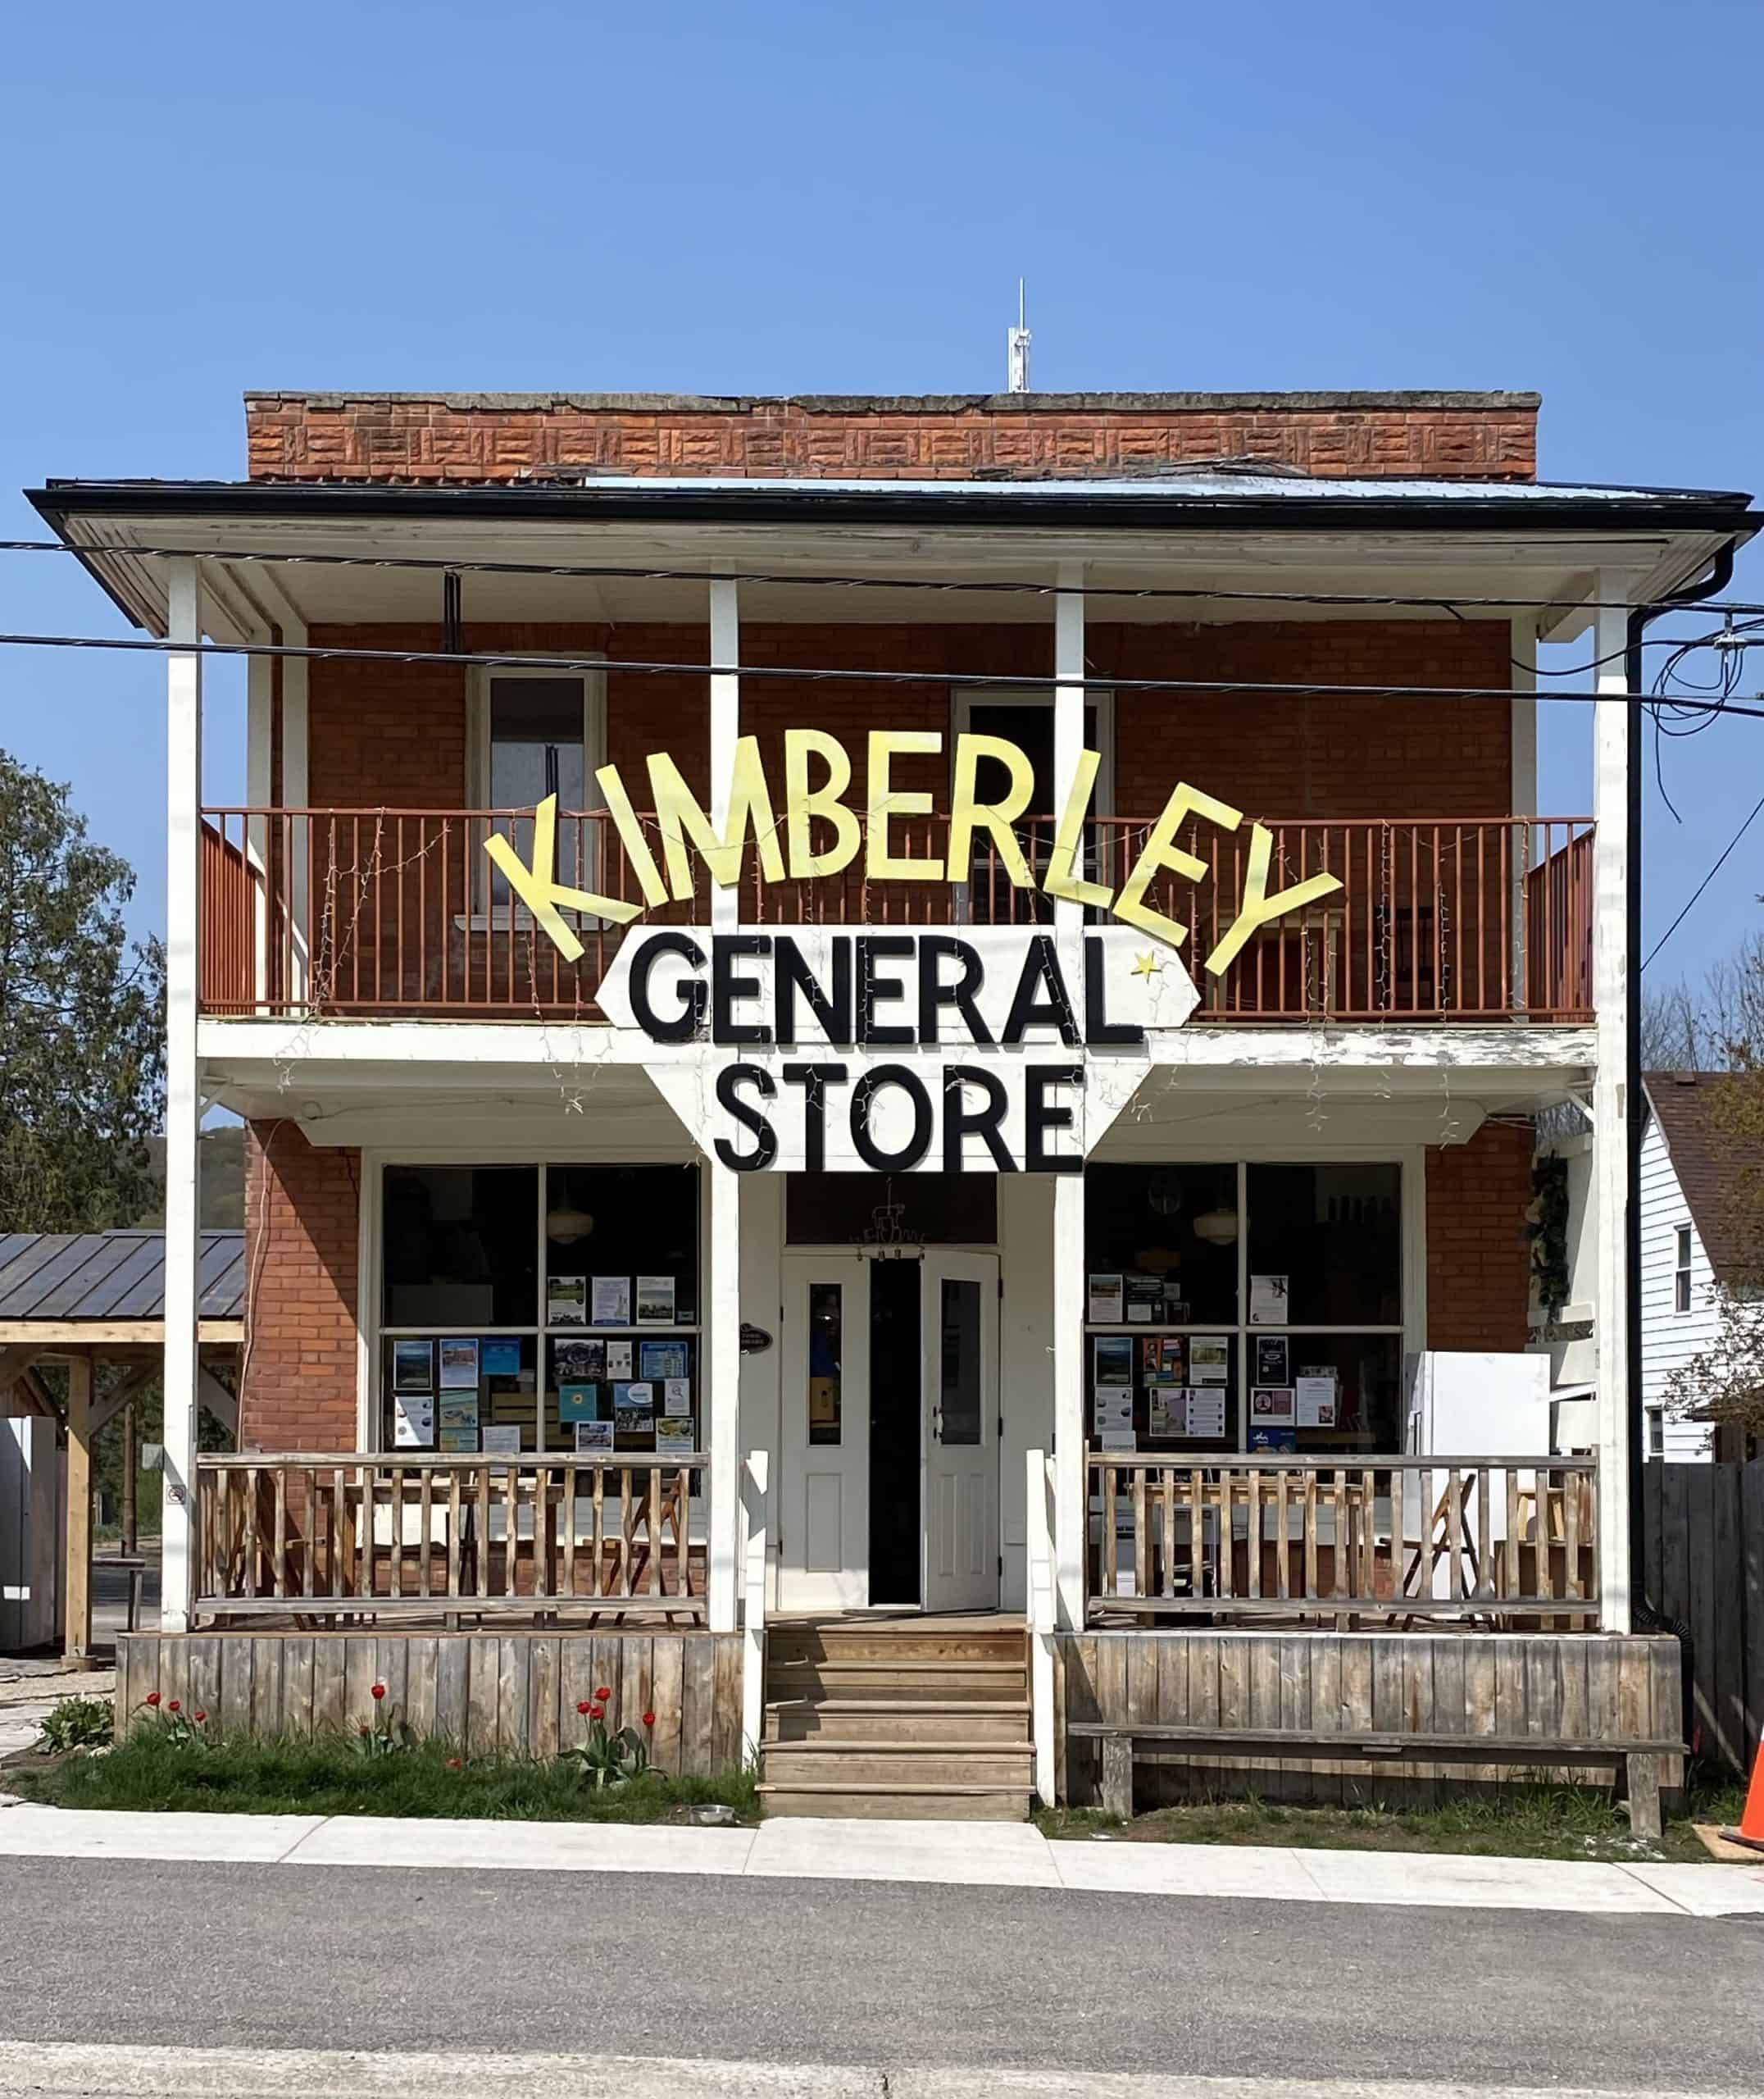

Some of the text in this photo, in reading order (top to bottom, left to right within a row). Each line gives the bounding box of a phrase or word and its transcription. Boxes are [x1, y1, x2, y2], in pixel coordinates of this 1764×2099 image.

[483, 729, 1344, 977] KIMBERLEY
[629, 931, 1144, 1045] GENERAL
[713, 1063, 1084, 1172] STORE
